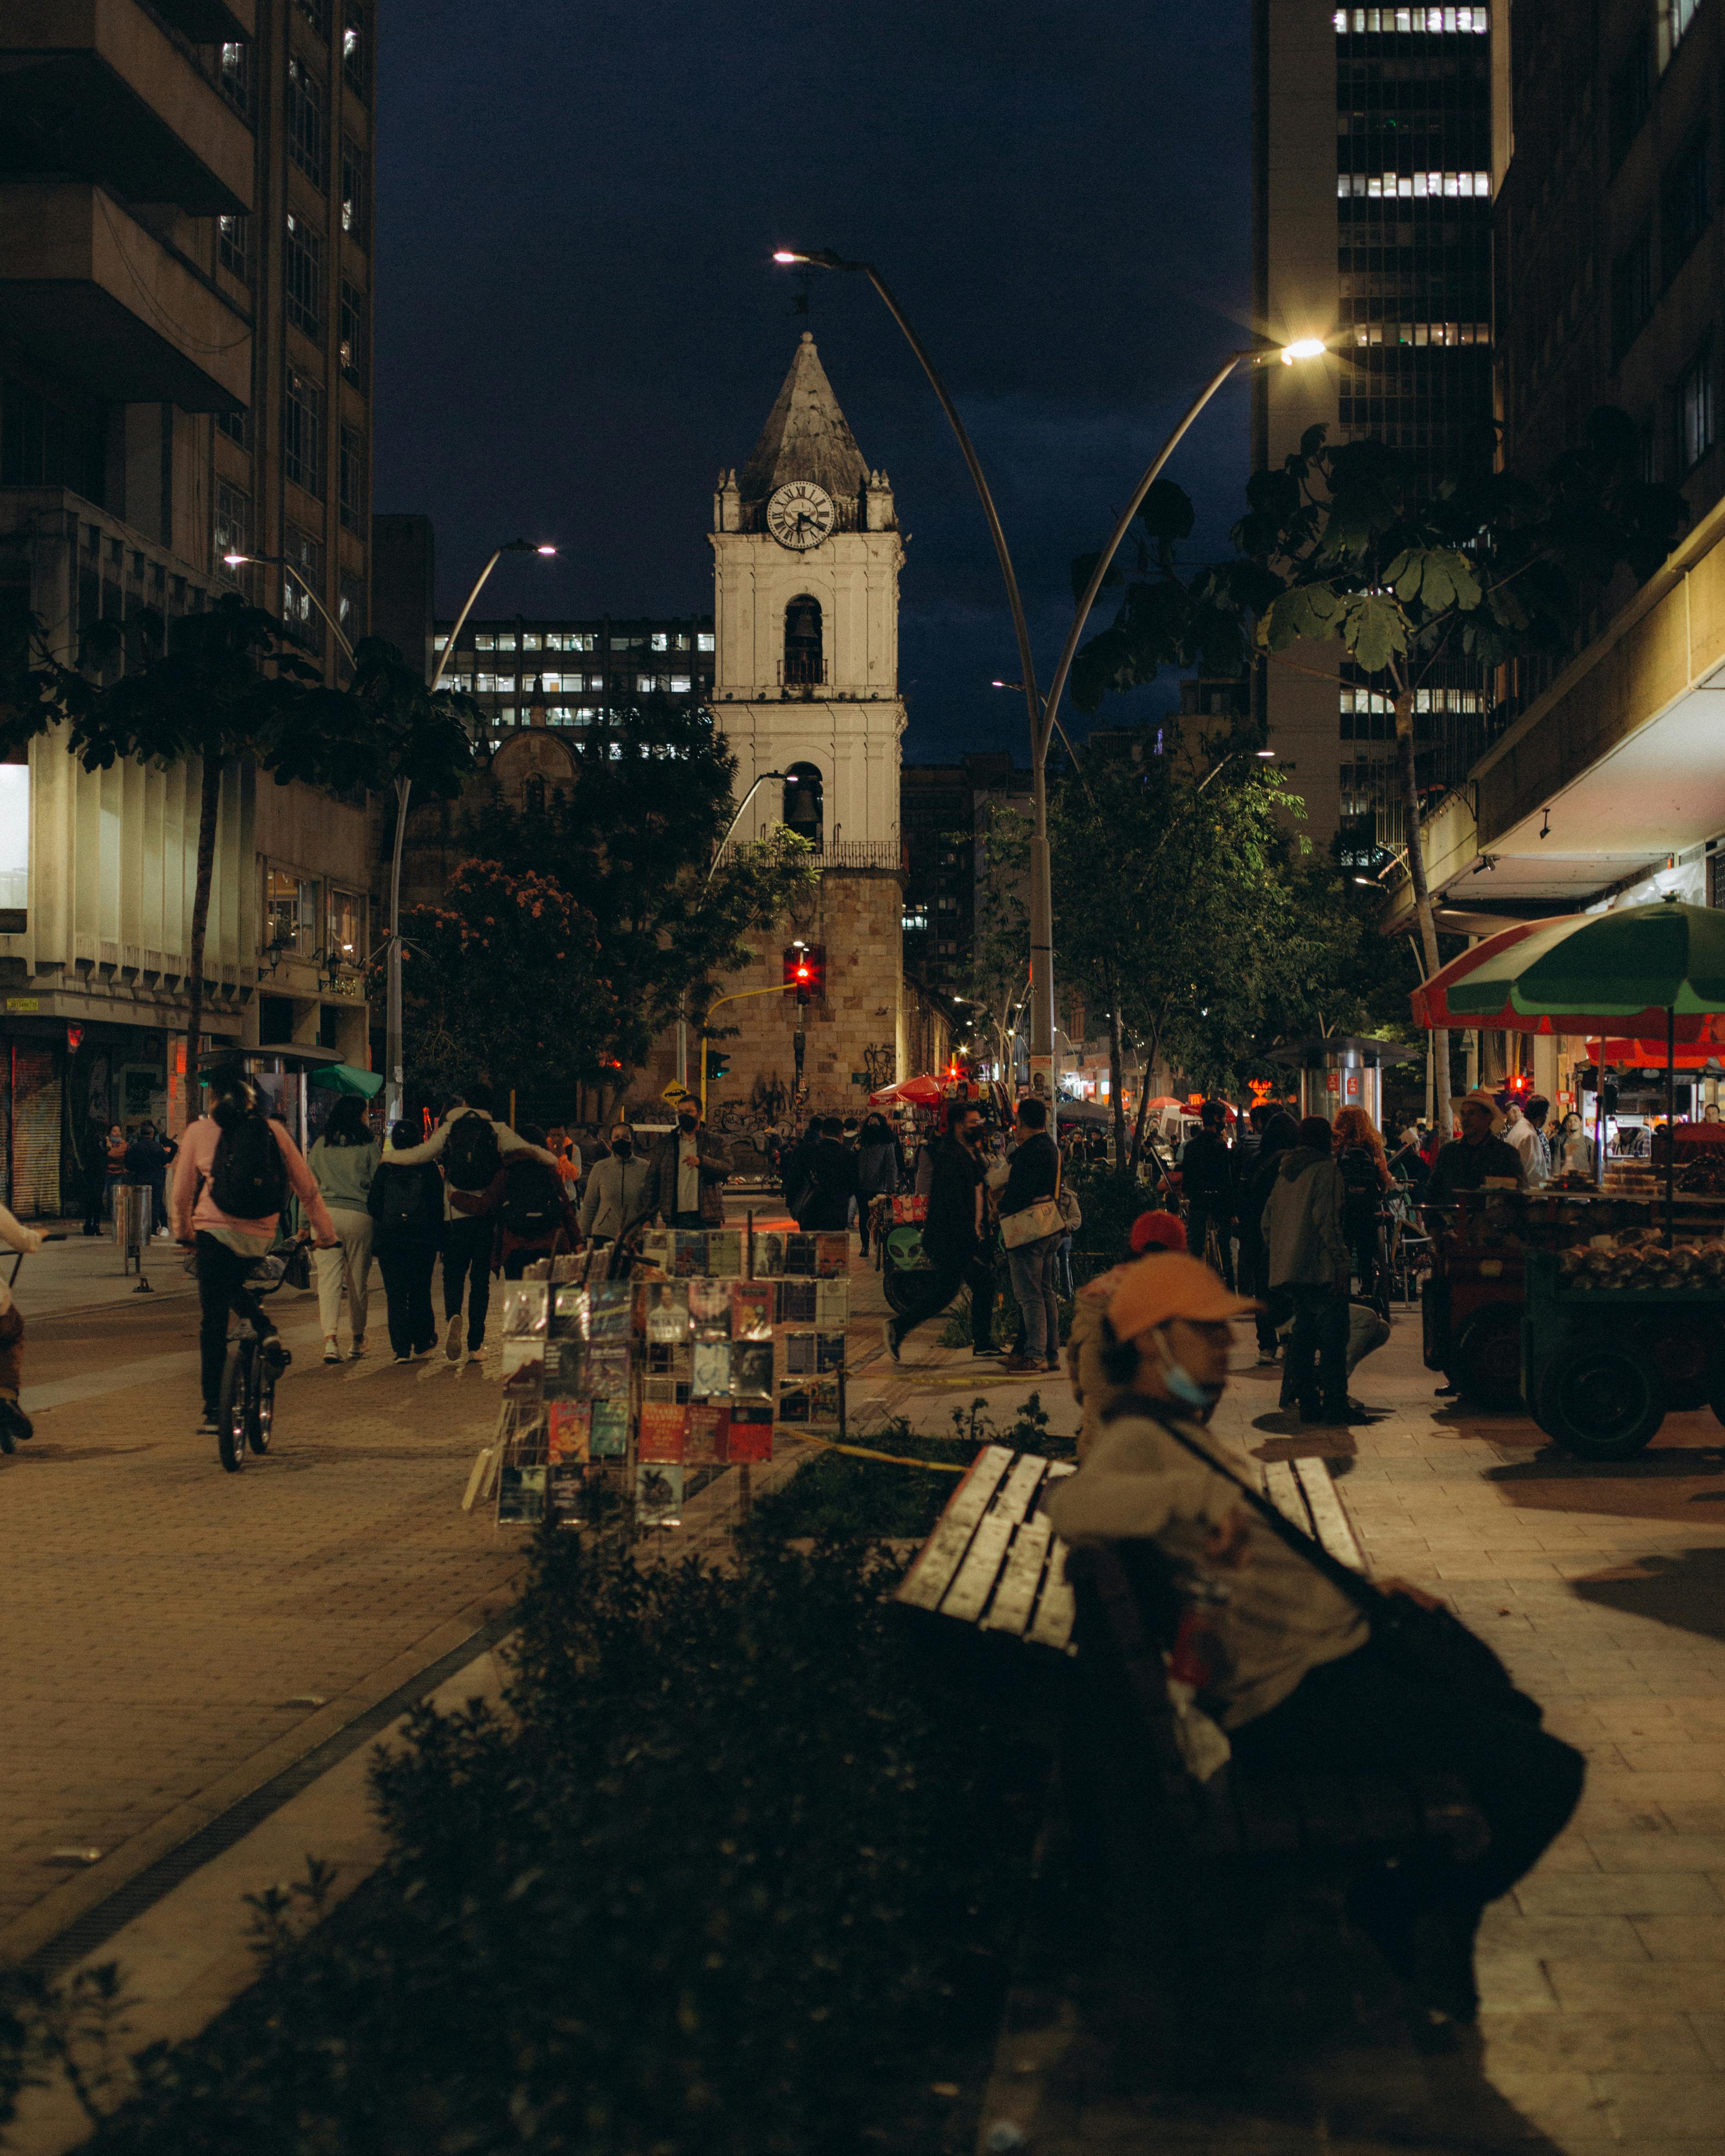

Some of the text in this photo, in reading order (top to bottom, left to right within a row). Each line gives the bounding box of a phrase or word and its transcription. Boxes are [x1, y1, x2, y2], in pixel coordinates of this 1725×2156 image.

[783, 489, 794, 500] XI
[796, 486, 806, 497] XII
[809, 490, 816, 499] I
[774, 499, 786, 508] X
